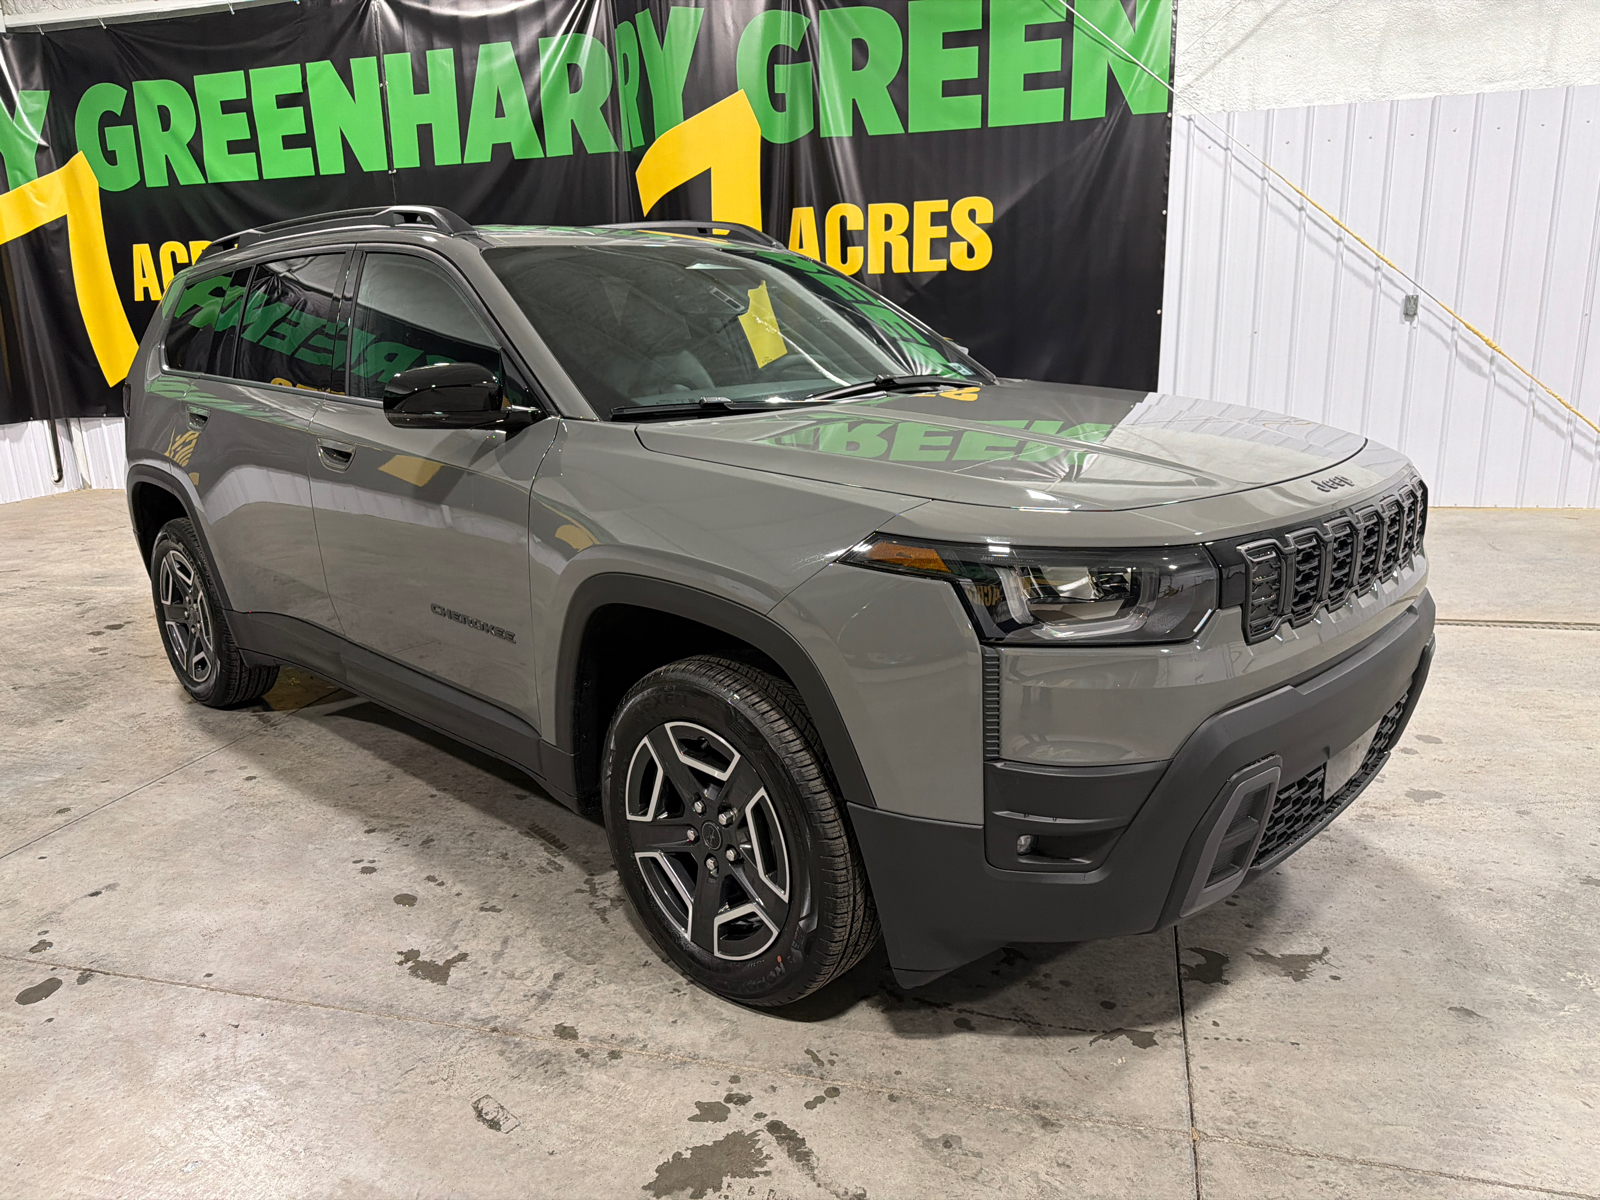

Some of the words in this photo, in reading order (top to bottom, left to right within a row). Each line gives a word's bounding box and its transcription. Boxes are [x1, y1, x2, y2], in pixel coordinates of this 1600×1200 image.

[75, 56, 388, 192] GREEN
[384, 6, 704, 169] HARRY
[737, 0, 1172, 144] GREEN
[788, 196, 994, 276] ACRES
[1311, 475, 1355, 492] Jeep
[430, 603, 516, 643] CHEROKEE
